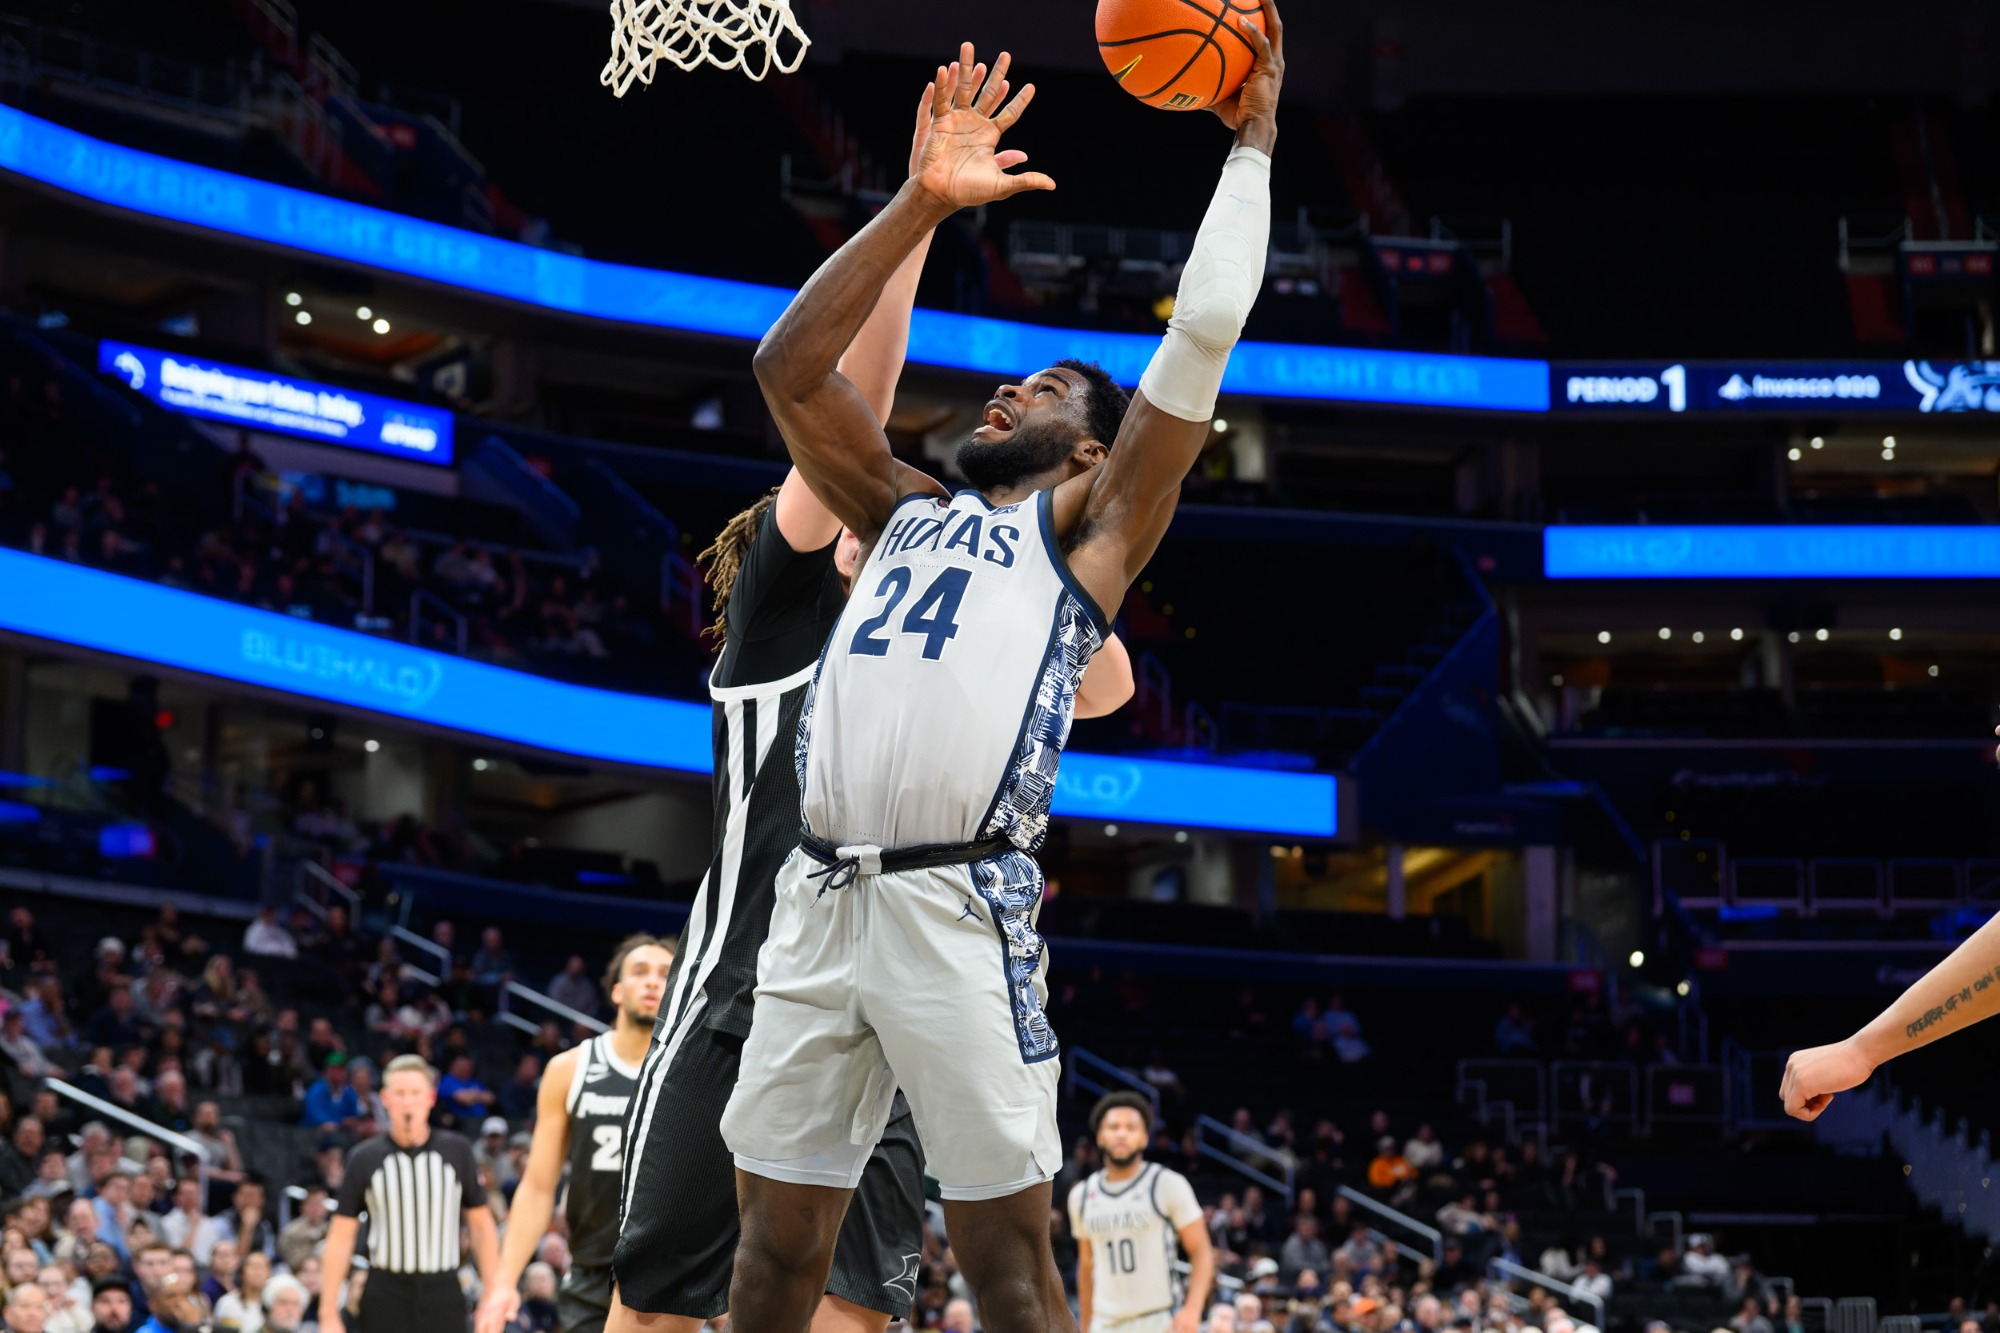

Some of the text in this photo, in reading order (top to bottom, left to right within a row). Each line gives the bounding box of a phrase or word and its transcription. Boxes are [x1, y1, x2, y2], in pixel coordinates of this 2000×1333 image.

[1567, 364, 1686, 412] PERIOD 1
[848, 565, 975, 662] 24
[590, 1124, 623, 1172] 2
[1105, 1238, 1136, 1276] 10
